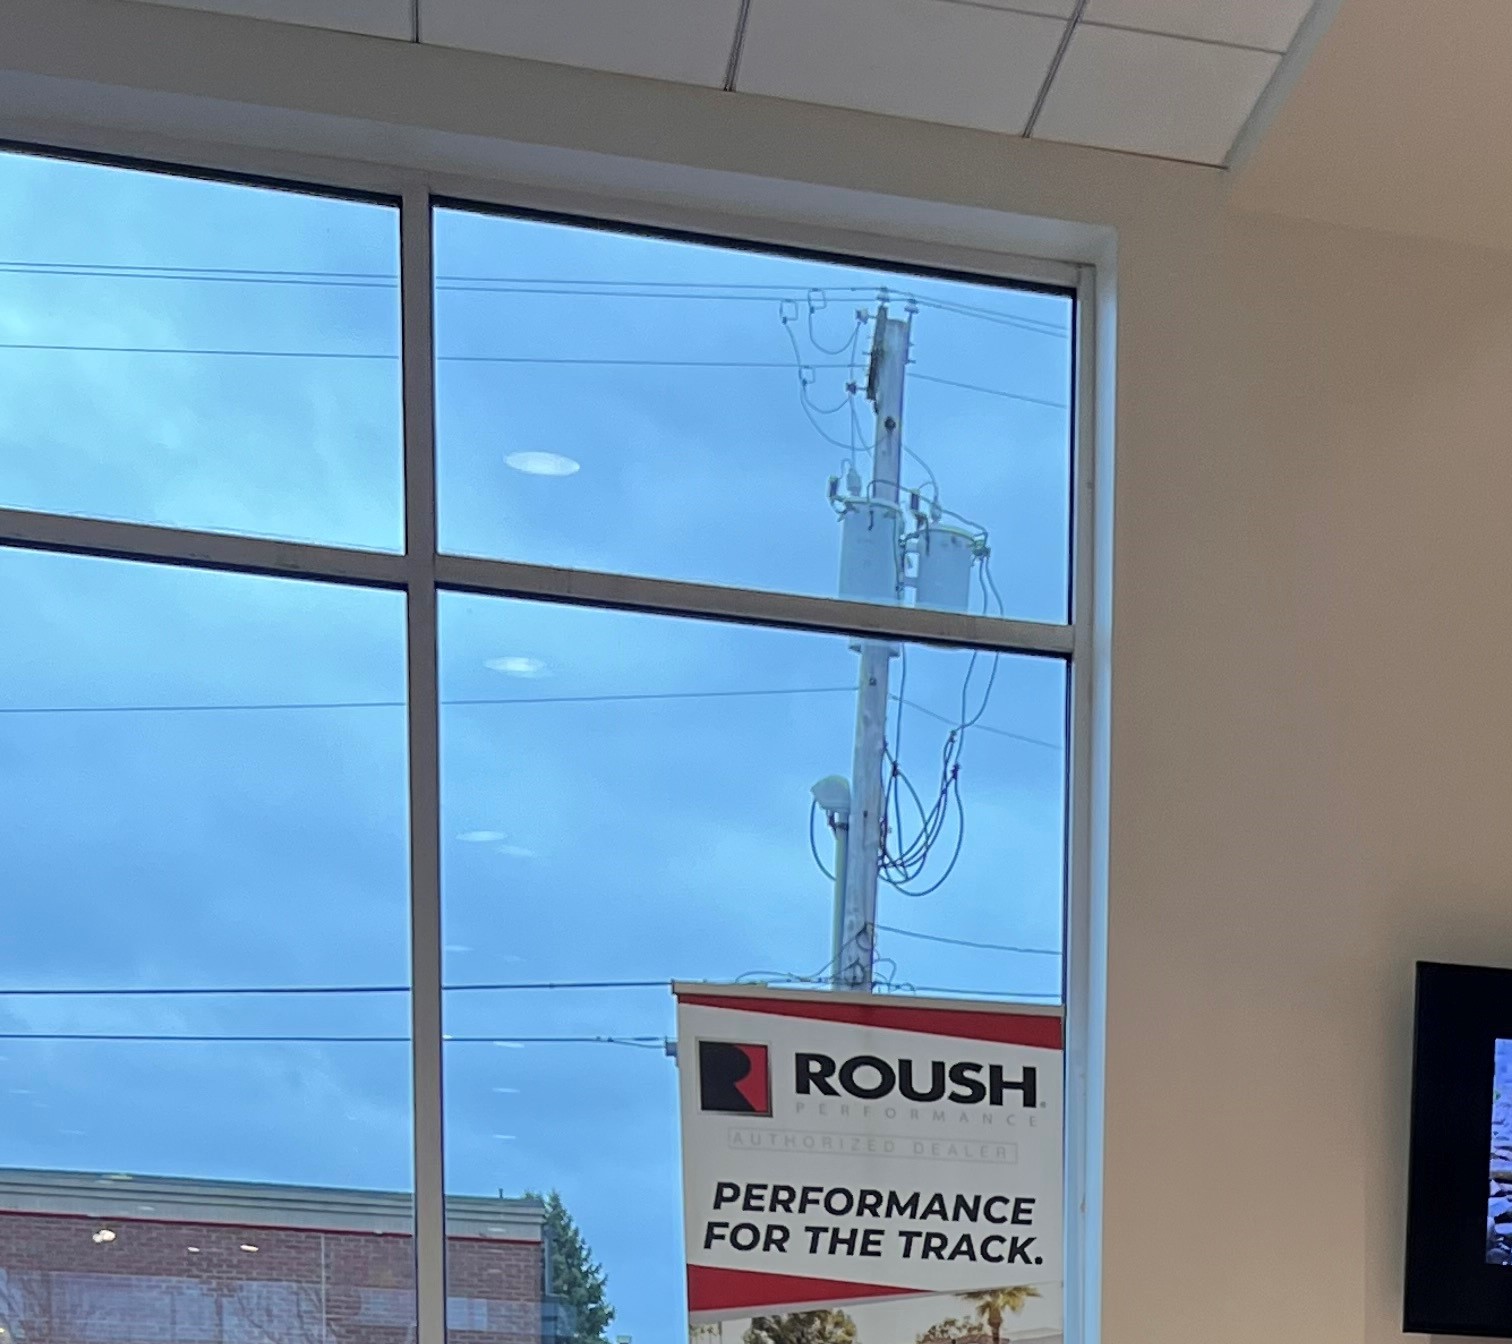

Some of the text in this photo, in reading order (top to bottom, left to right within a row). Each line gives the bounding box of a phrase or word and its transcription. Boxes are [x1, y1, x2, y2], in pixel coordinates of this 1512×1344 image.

[795, 1052, 1038, 1108] ROUSH
[795, 1103, 1038, 1127] PERFORMANCE
[732, 1131, 1008, 1160] AUTHORIZED DEALER
[713, 1182, 1036, 1225] PERFORMANCE
[703, 1221, 1043, 1265] FOR THE TRACK.
